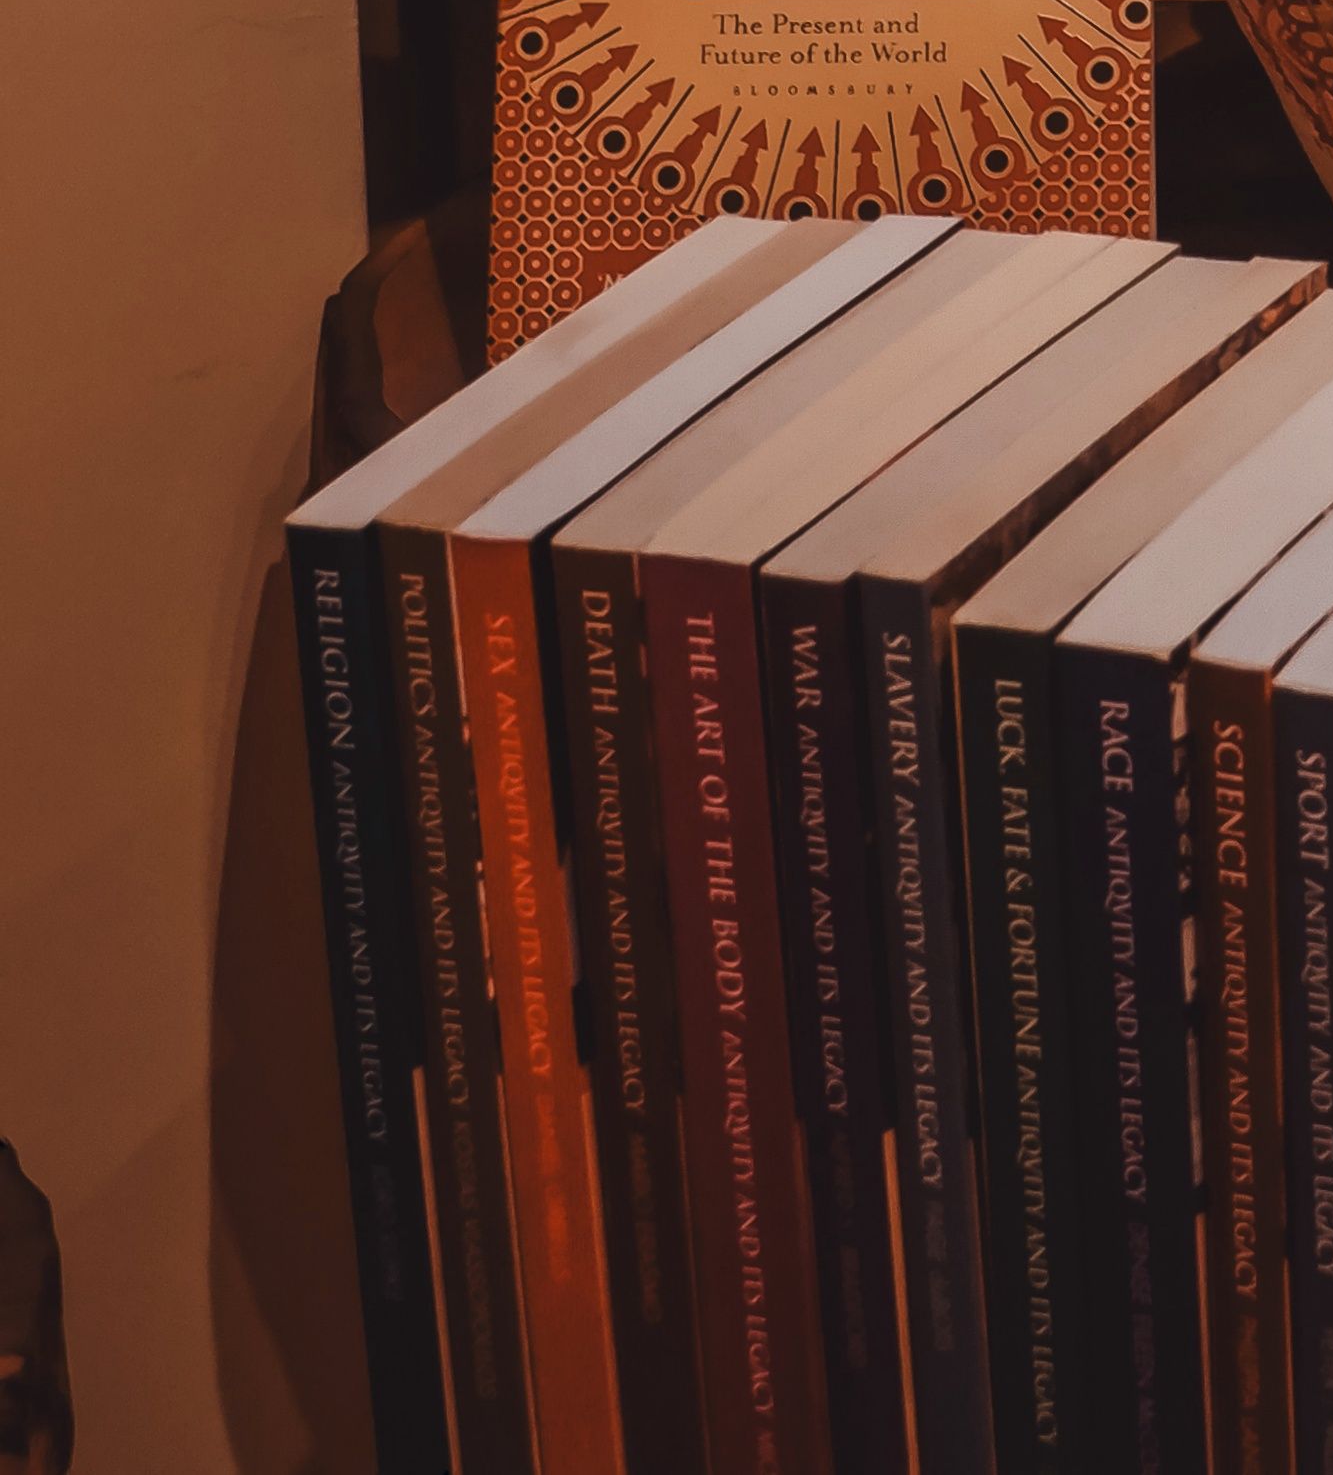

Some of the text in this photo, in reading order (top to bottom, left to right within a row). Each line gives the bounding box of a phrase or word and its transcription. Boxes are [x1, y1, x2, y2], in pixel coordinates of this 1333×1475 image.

[700, 42, 948, 66] Future of the World
[712, 13, 920, 36] The Present and
[733, 83, 915, 96] BLOOMSBURY
[314, 569, 354, 750] RELIGION
[400, 573, 436, 719] POLITICS
[484, 613, 515, 675] SEX
[580, 590, 618, 713] DEATH
[882, 632, 918, 785] SLAVERY
[1099, 699, 1134, 793] RACE
[1000, 786, 1032, 859] FATE
[1214, 720, 1246, 888] SCIENCE
[1296, 749, 1329, 869] SPORT
[1006, 868, 1033, 893] &
[1007, 903, 1042, 1060] FORTUNE
[1309, 1045, 1333, 1112] AND
[1312, 1124, 1333, 1162] ITS
